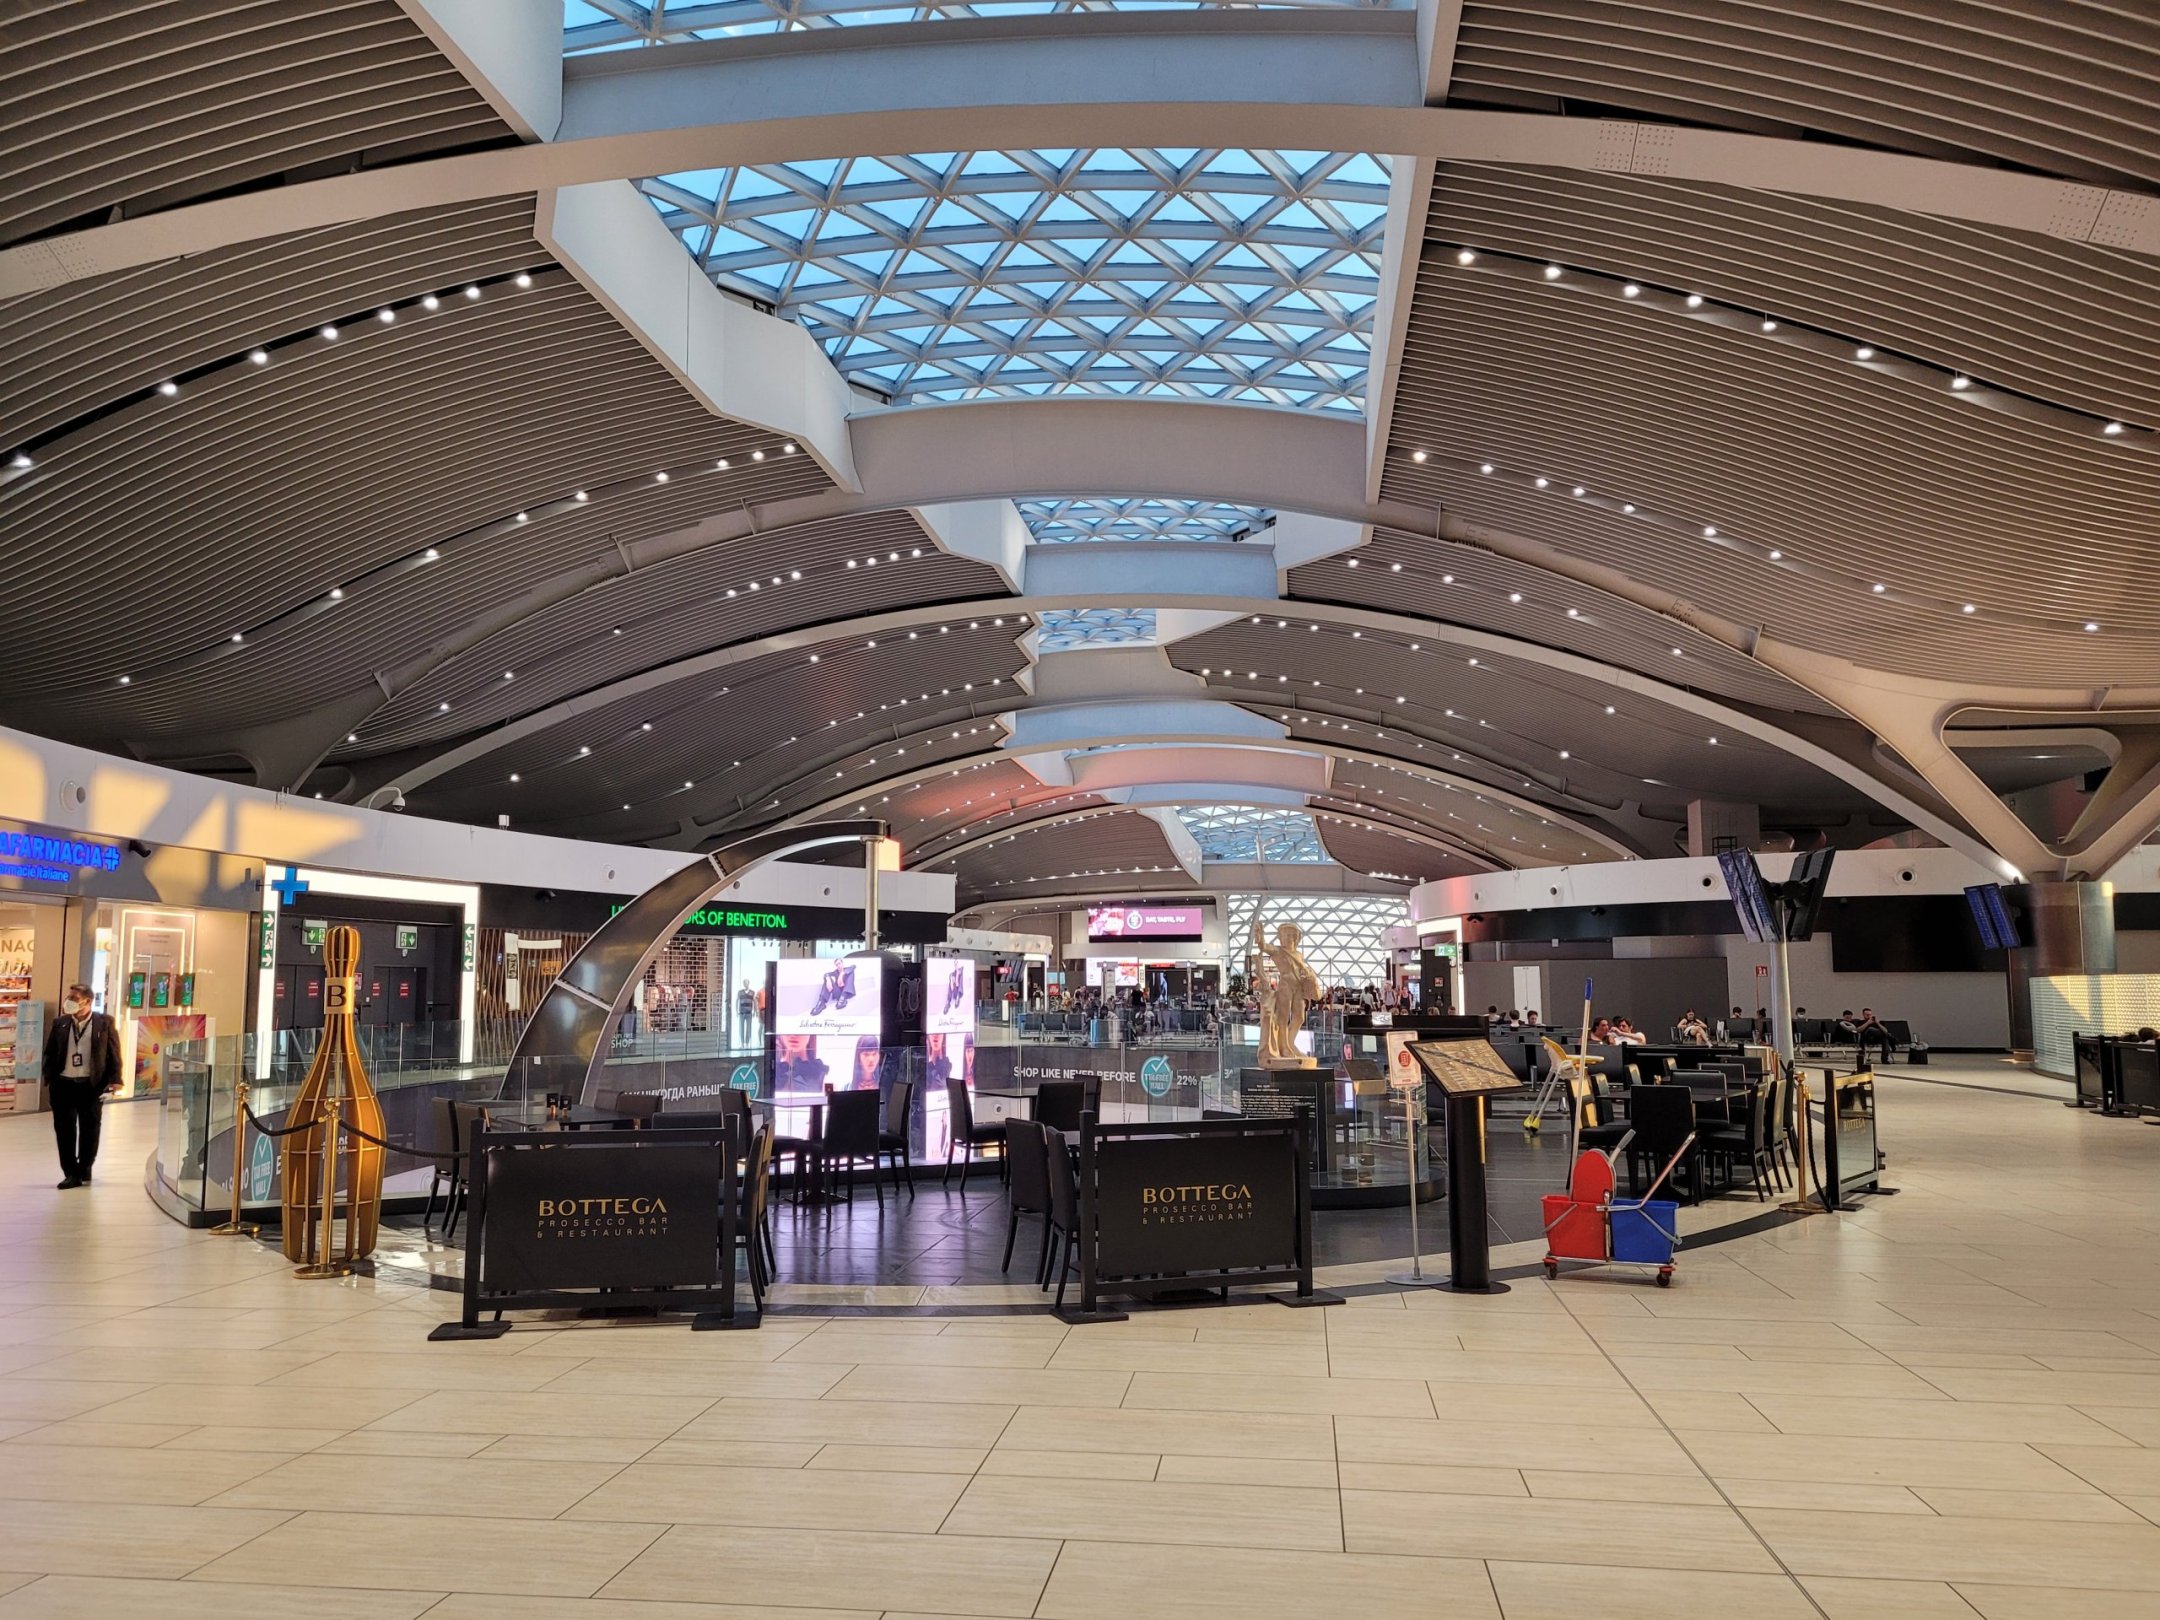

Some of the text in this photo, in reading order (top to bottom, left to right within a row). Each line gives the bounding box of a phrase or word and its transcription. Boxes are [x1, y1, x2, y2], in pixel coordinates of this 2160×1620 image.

[37, 865, 70, 882] Italiane
[707, 911, 724, 926] OF
[326, 984, 347, 1008] B
[611, 1039, 634, 1049] SHOP
[1013, 1066, 1039, 1078] SHOP
[1041, 1067, 1061, 1079] LIKE
[1176, 1075, 1198, 1086] 22%
[1143, 1184, 1252, 1204] BOTTEGA
[539, 1197, 667, 1217] BOTTEGA
[1143, 1202, 1252, 1214] PROSECCO BAR
[538, 1217, 668, 1228] PROSECCO BAR
[1160, 1212, 1252, 1224] RESTAURANT
[537, 1227, 668, 1239] & RESTAURANT
